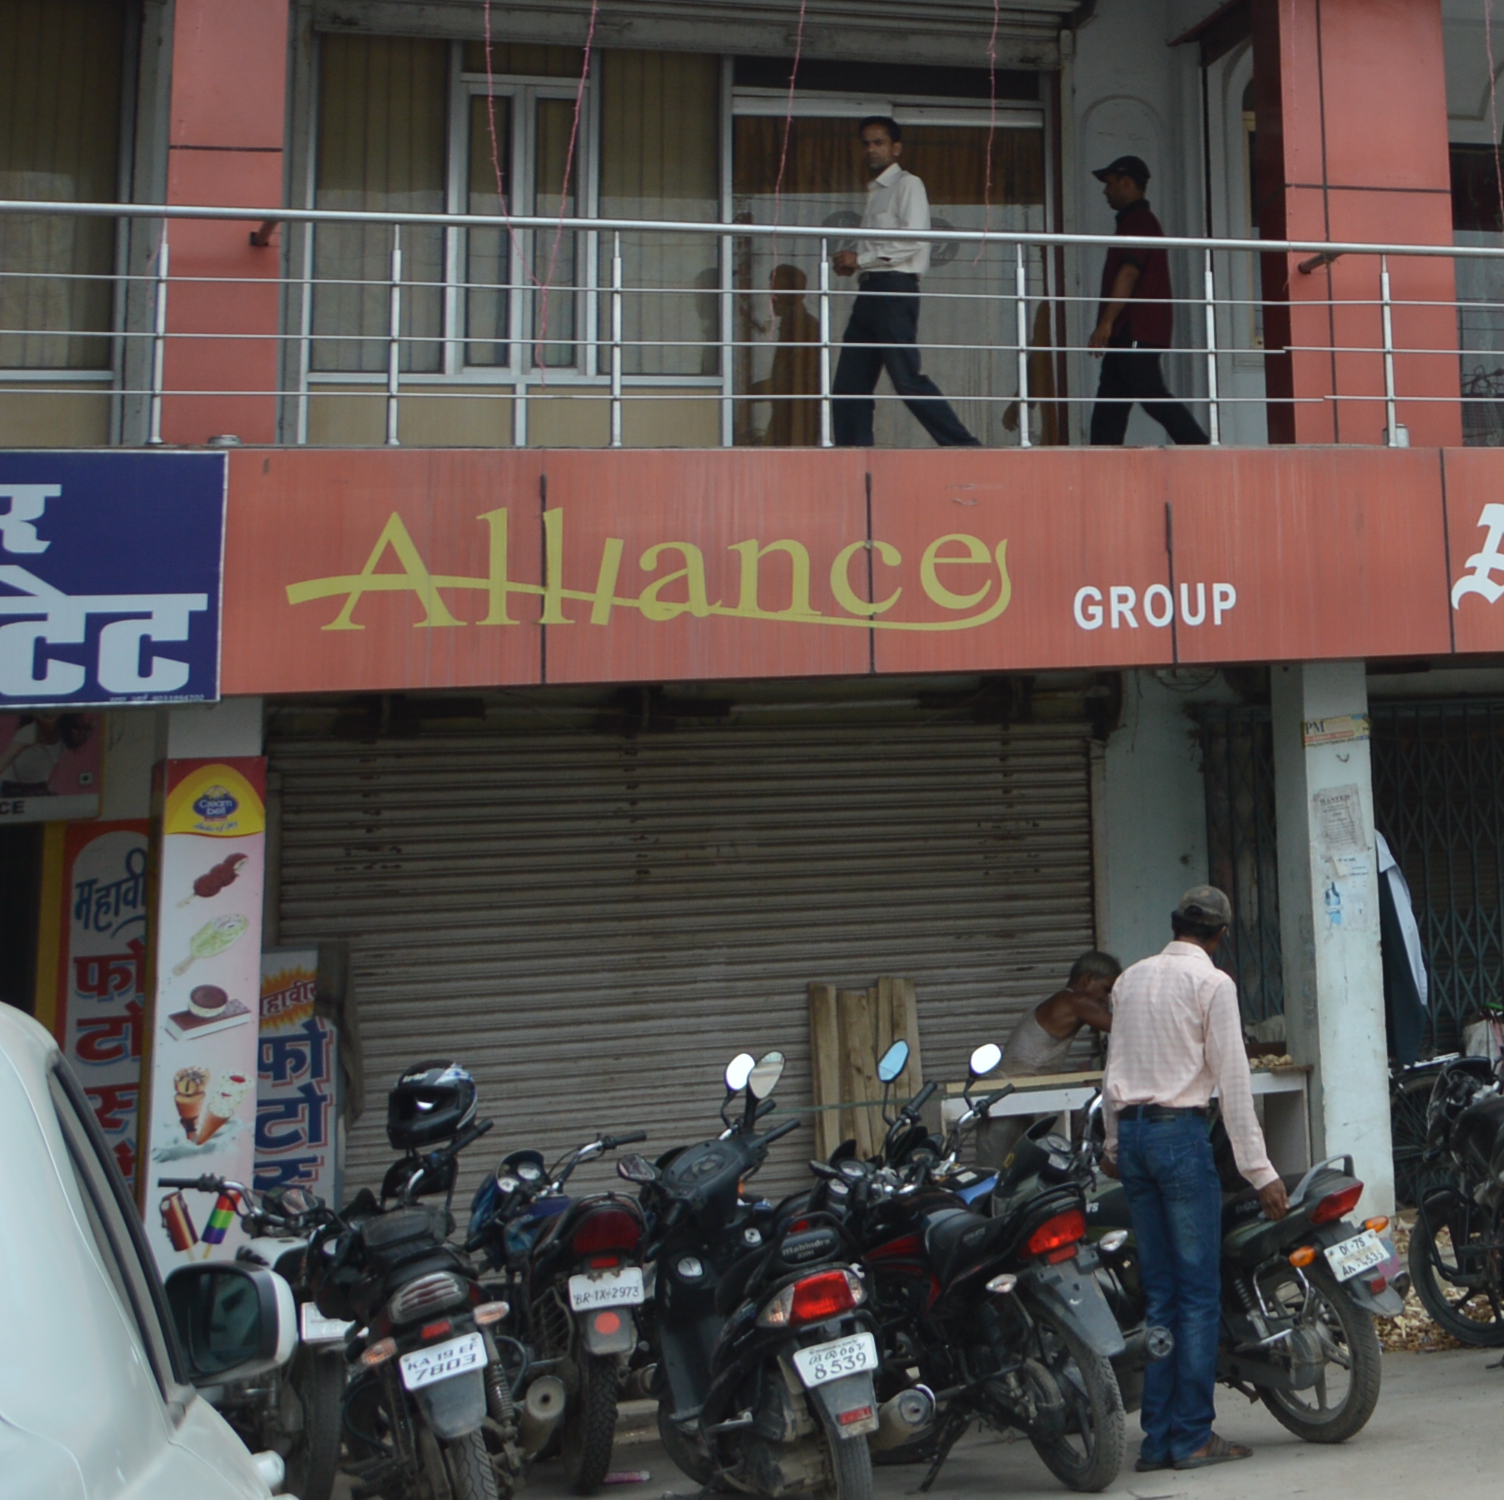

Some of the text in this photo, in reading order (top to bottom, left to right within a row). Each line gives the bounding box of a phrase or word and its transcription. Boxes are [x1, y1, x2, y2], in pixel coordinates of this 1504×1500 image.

[286, 506, 1237, 632] Alliance GROUP
[407, 1357, 431, 1371] KA
[437, 1349, 454, 1361] 19
[414, 1353, 477, 1381] 7803
[814, 1351, 867, 1380] 8539
